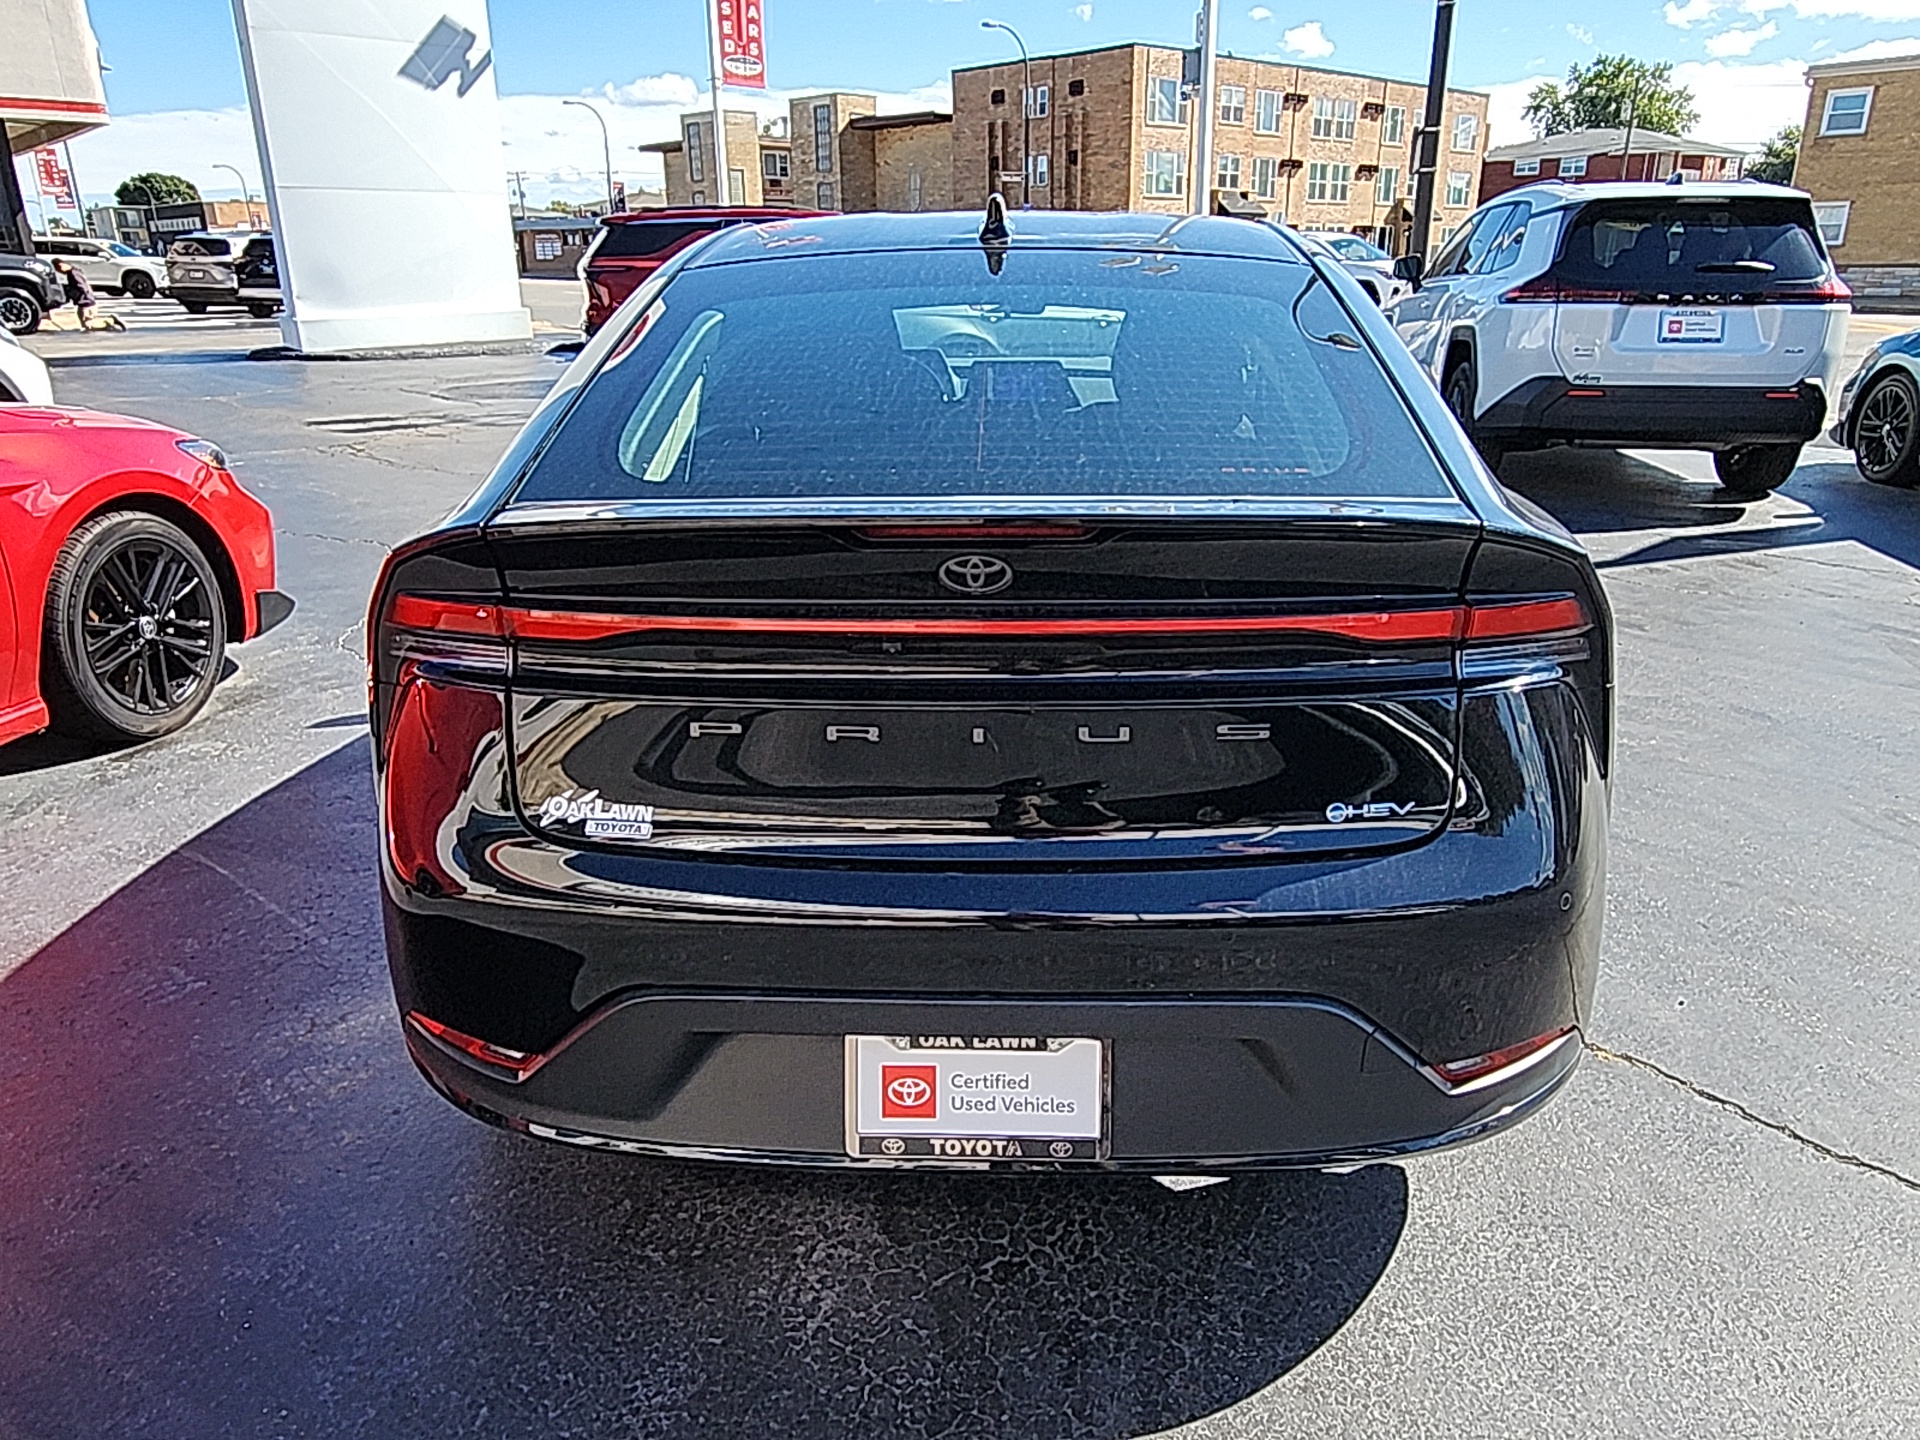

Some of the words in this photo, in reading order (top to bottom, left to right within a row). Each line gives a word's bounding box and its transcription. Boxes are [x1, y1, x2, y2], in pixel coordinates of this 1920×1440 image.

[689, 721, 1271, 743] PRIUS
[593, 822, 642, 834] TOYOTA
[918, 1036, 966, 1048] OAK
[972, 1037, 1037, 1049] LAWN
[950, 1073, 1030, 1090] Certified
[950, 1095, 997, 1112] Used
[1000, 1096, 1076, 1114] Vehicles
[929, 1138, 1024, 1157] TOYOTA
